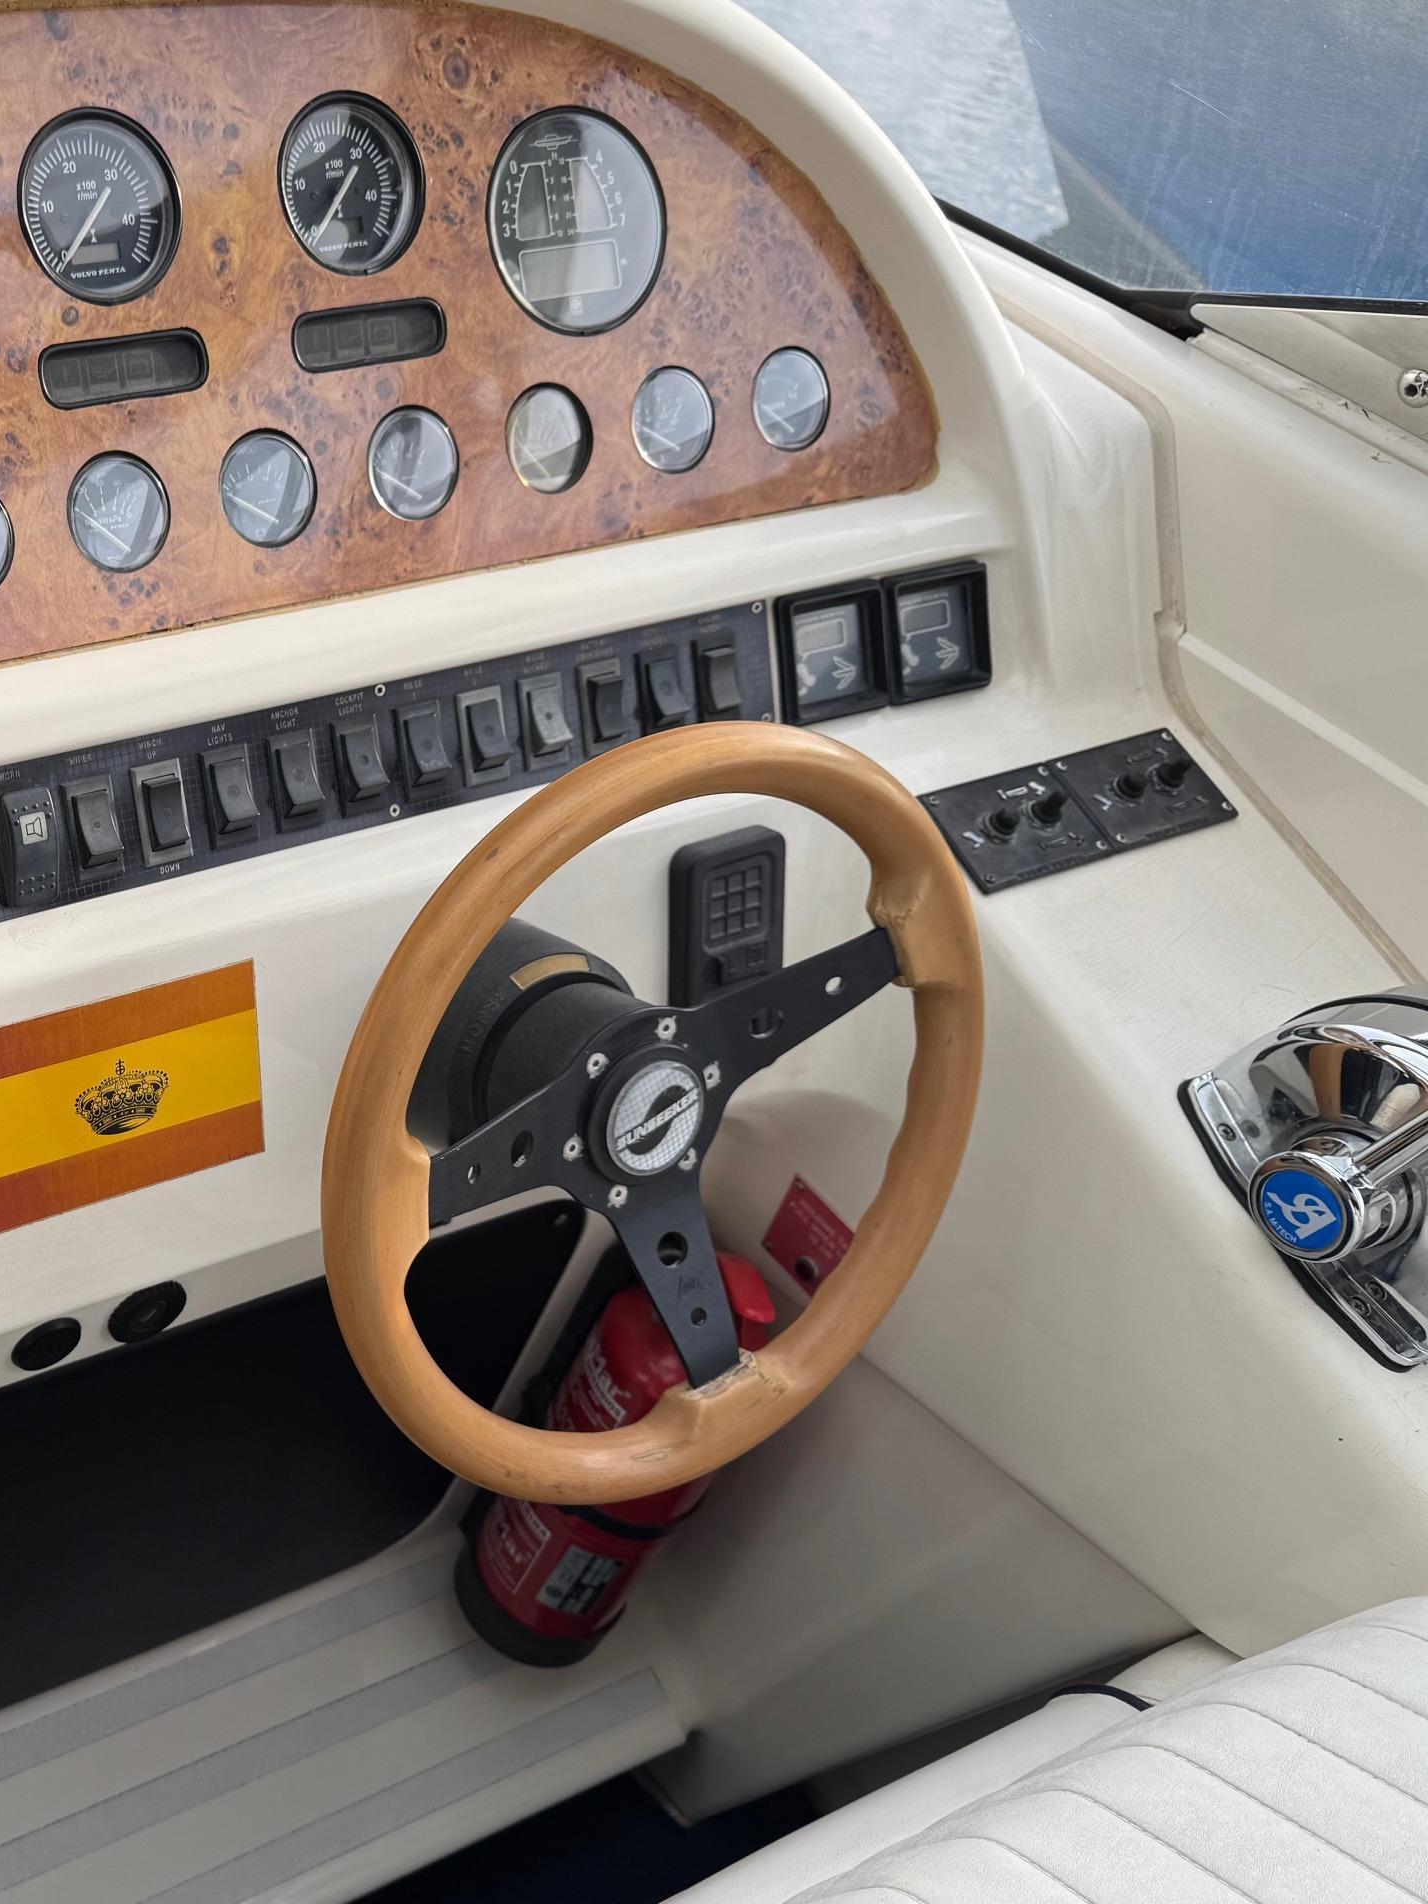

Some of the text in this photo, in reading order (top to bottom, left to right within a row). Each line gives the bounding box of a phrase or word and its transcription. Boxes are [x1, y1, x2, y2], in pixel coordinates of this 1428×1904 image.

[314, 142, 325, 153] 20
[350, 148, 362, 160] 30
[596, 149, 603, 163] 4
[62, 161, 77, 174] 20
[509, 160, 518, 175] 0
[104, 168, 118, 181] 30
[607, 171, 615, 185] 5
[294, 179, 306, 191] 10
[365, 190, 378, 202] 40
[615, 191, 622, 205] 6
[41, 200, 54, 213] 10
[502, 199, 510, 214] 2
[122, 213, 135, 226] 40
[502, 223, 511, 237] 3
[70, 266, 126, 279] VOLVO PENTA
[334, 691, 364, 706] COCKPIT
[270, 706, 299, 721] ANCHOR
[338, 703, 364, 717] LIGHTS
[211, 722, 226, 734] NAV
[275, 721, 297, 731] LIGHT
[138, 737, 162, 750] WINCH
[207, 732, 234, 746] LIGHTS
[68, 753, 93, 766] WIPER
[147, 751, 157, 760] UP
[0, 770, 21, 782] HORN
[159, 862, 180, 875] DOWN
